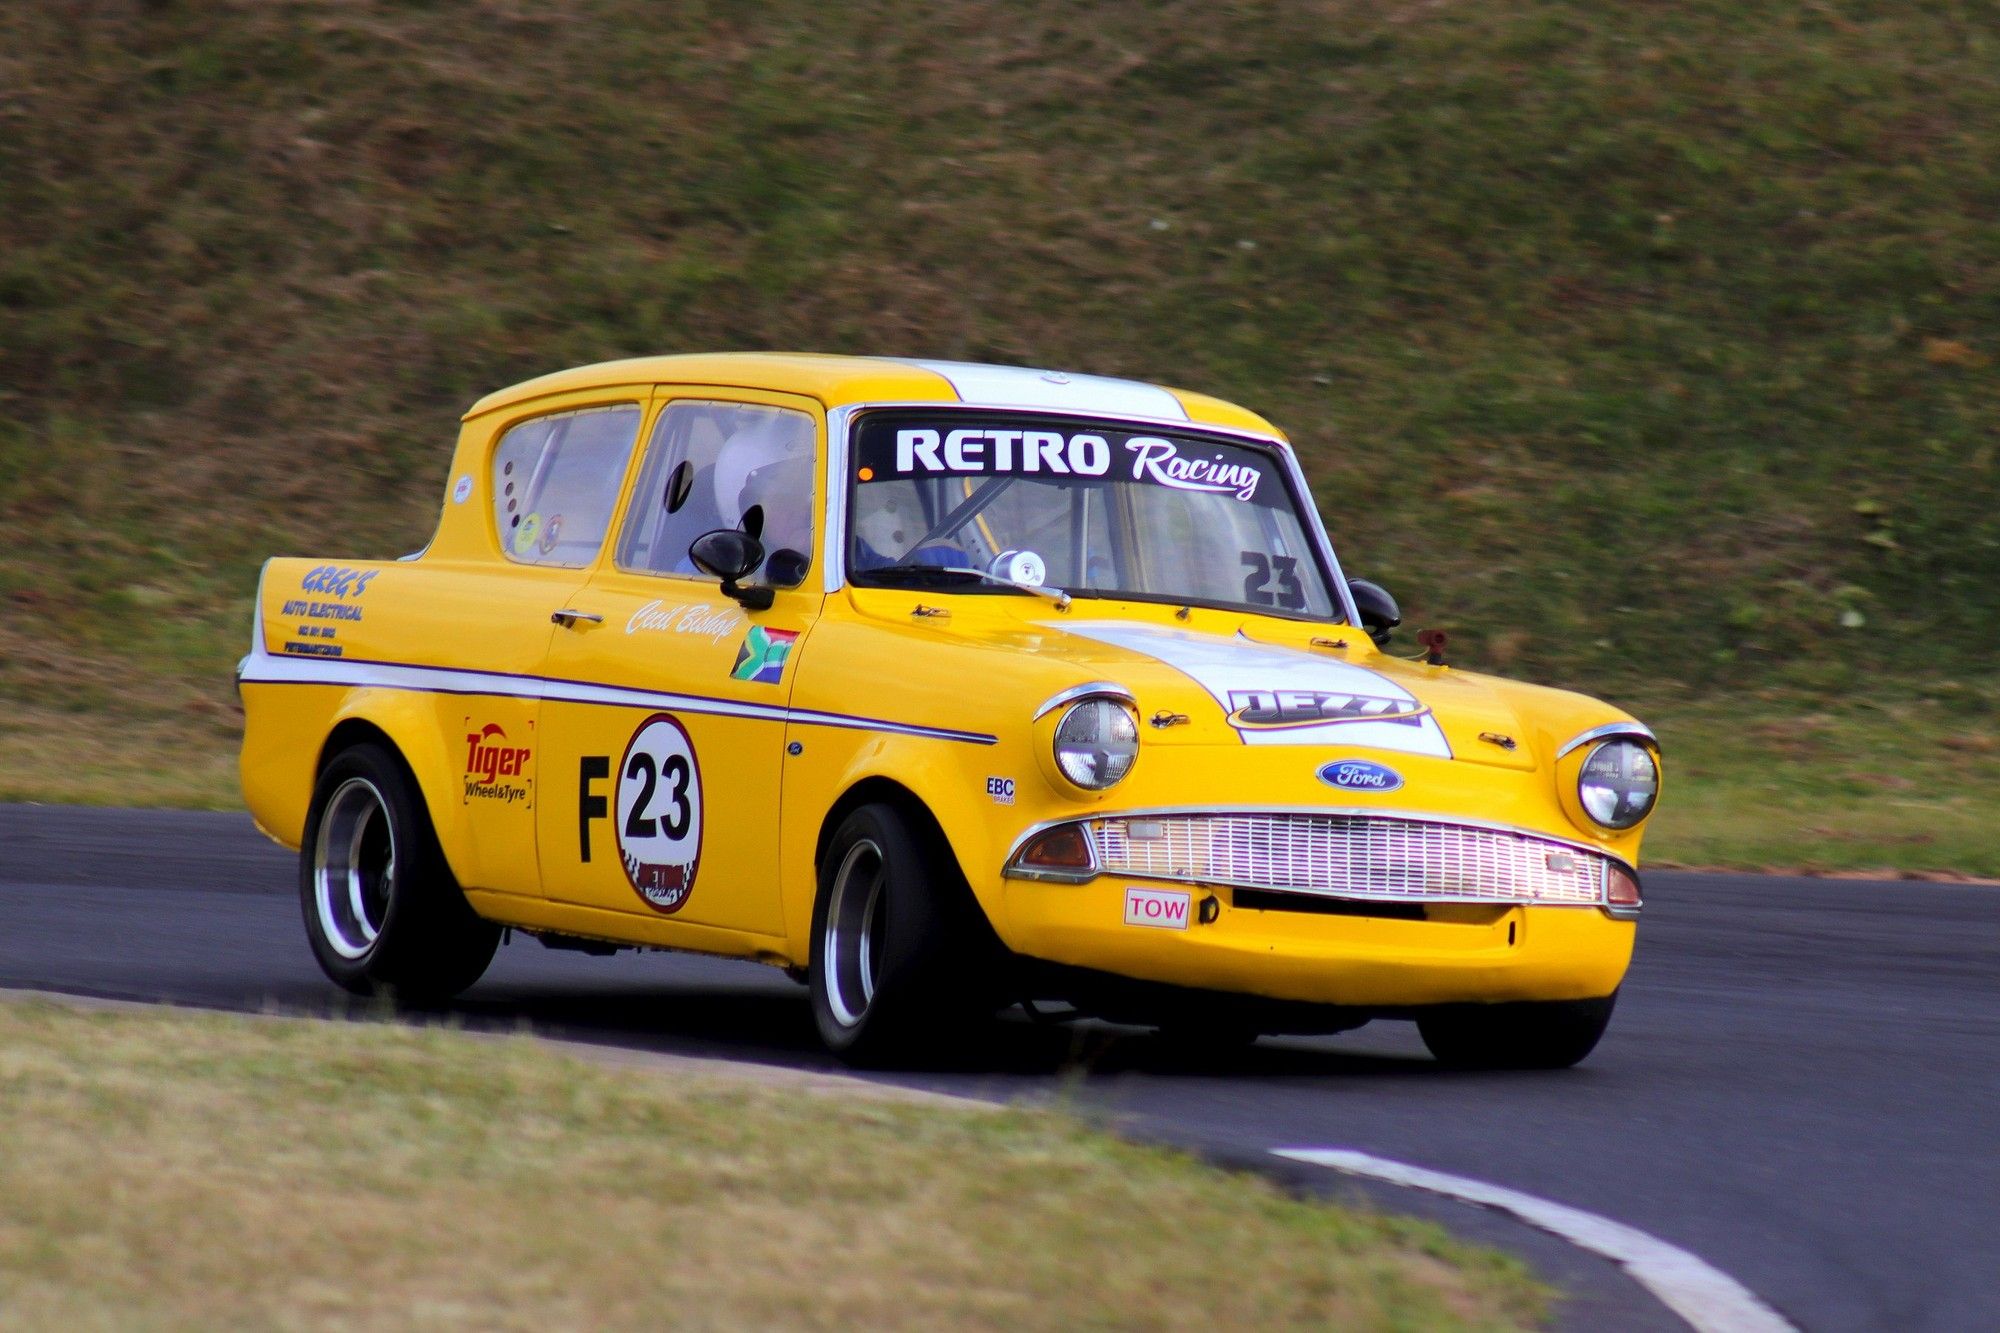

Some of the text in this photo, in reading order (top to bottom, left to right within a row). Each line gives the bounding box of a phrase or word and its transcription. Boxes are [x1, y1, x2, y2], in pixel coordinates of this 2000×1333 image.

[897, 429, 1261, 501] RETRO Racing
[1241, 551, 1306, 609] 23
[282, 600, 362, 621] AUTO ELECTRICAL
[466, 732, 531, 785] Tiger
[1336, 763, 1386, 786] Ford
[464, 781, 526, 804] Wheel&Tyre
[624, 751, 692, 842] 23
[987, 777, 1014, 796] EBC
[579, 755, 610, 863] F
[1131, 897, 1186, 920] TOW
